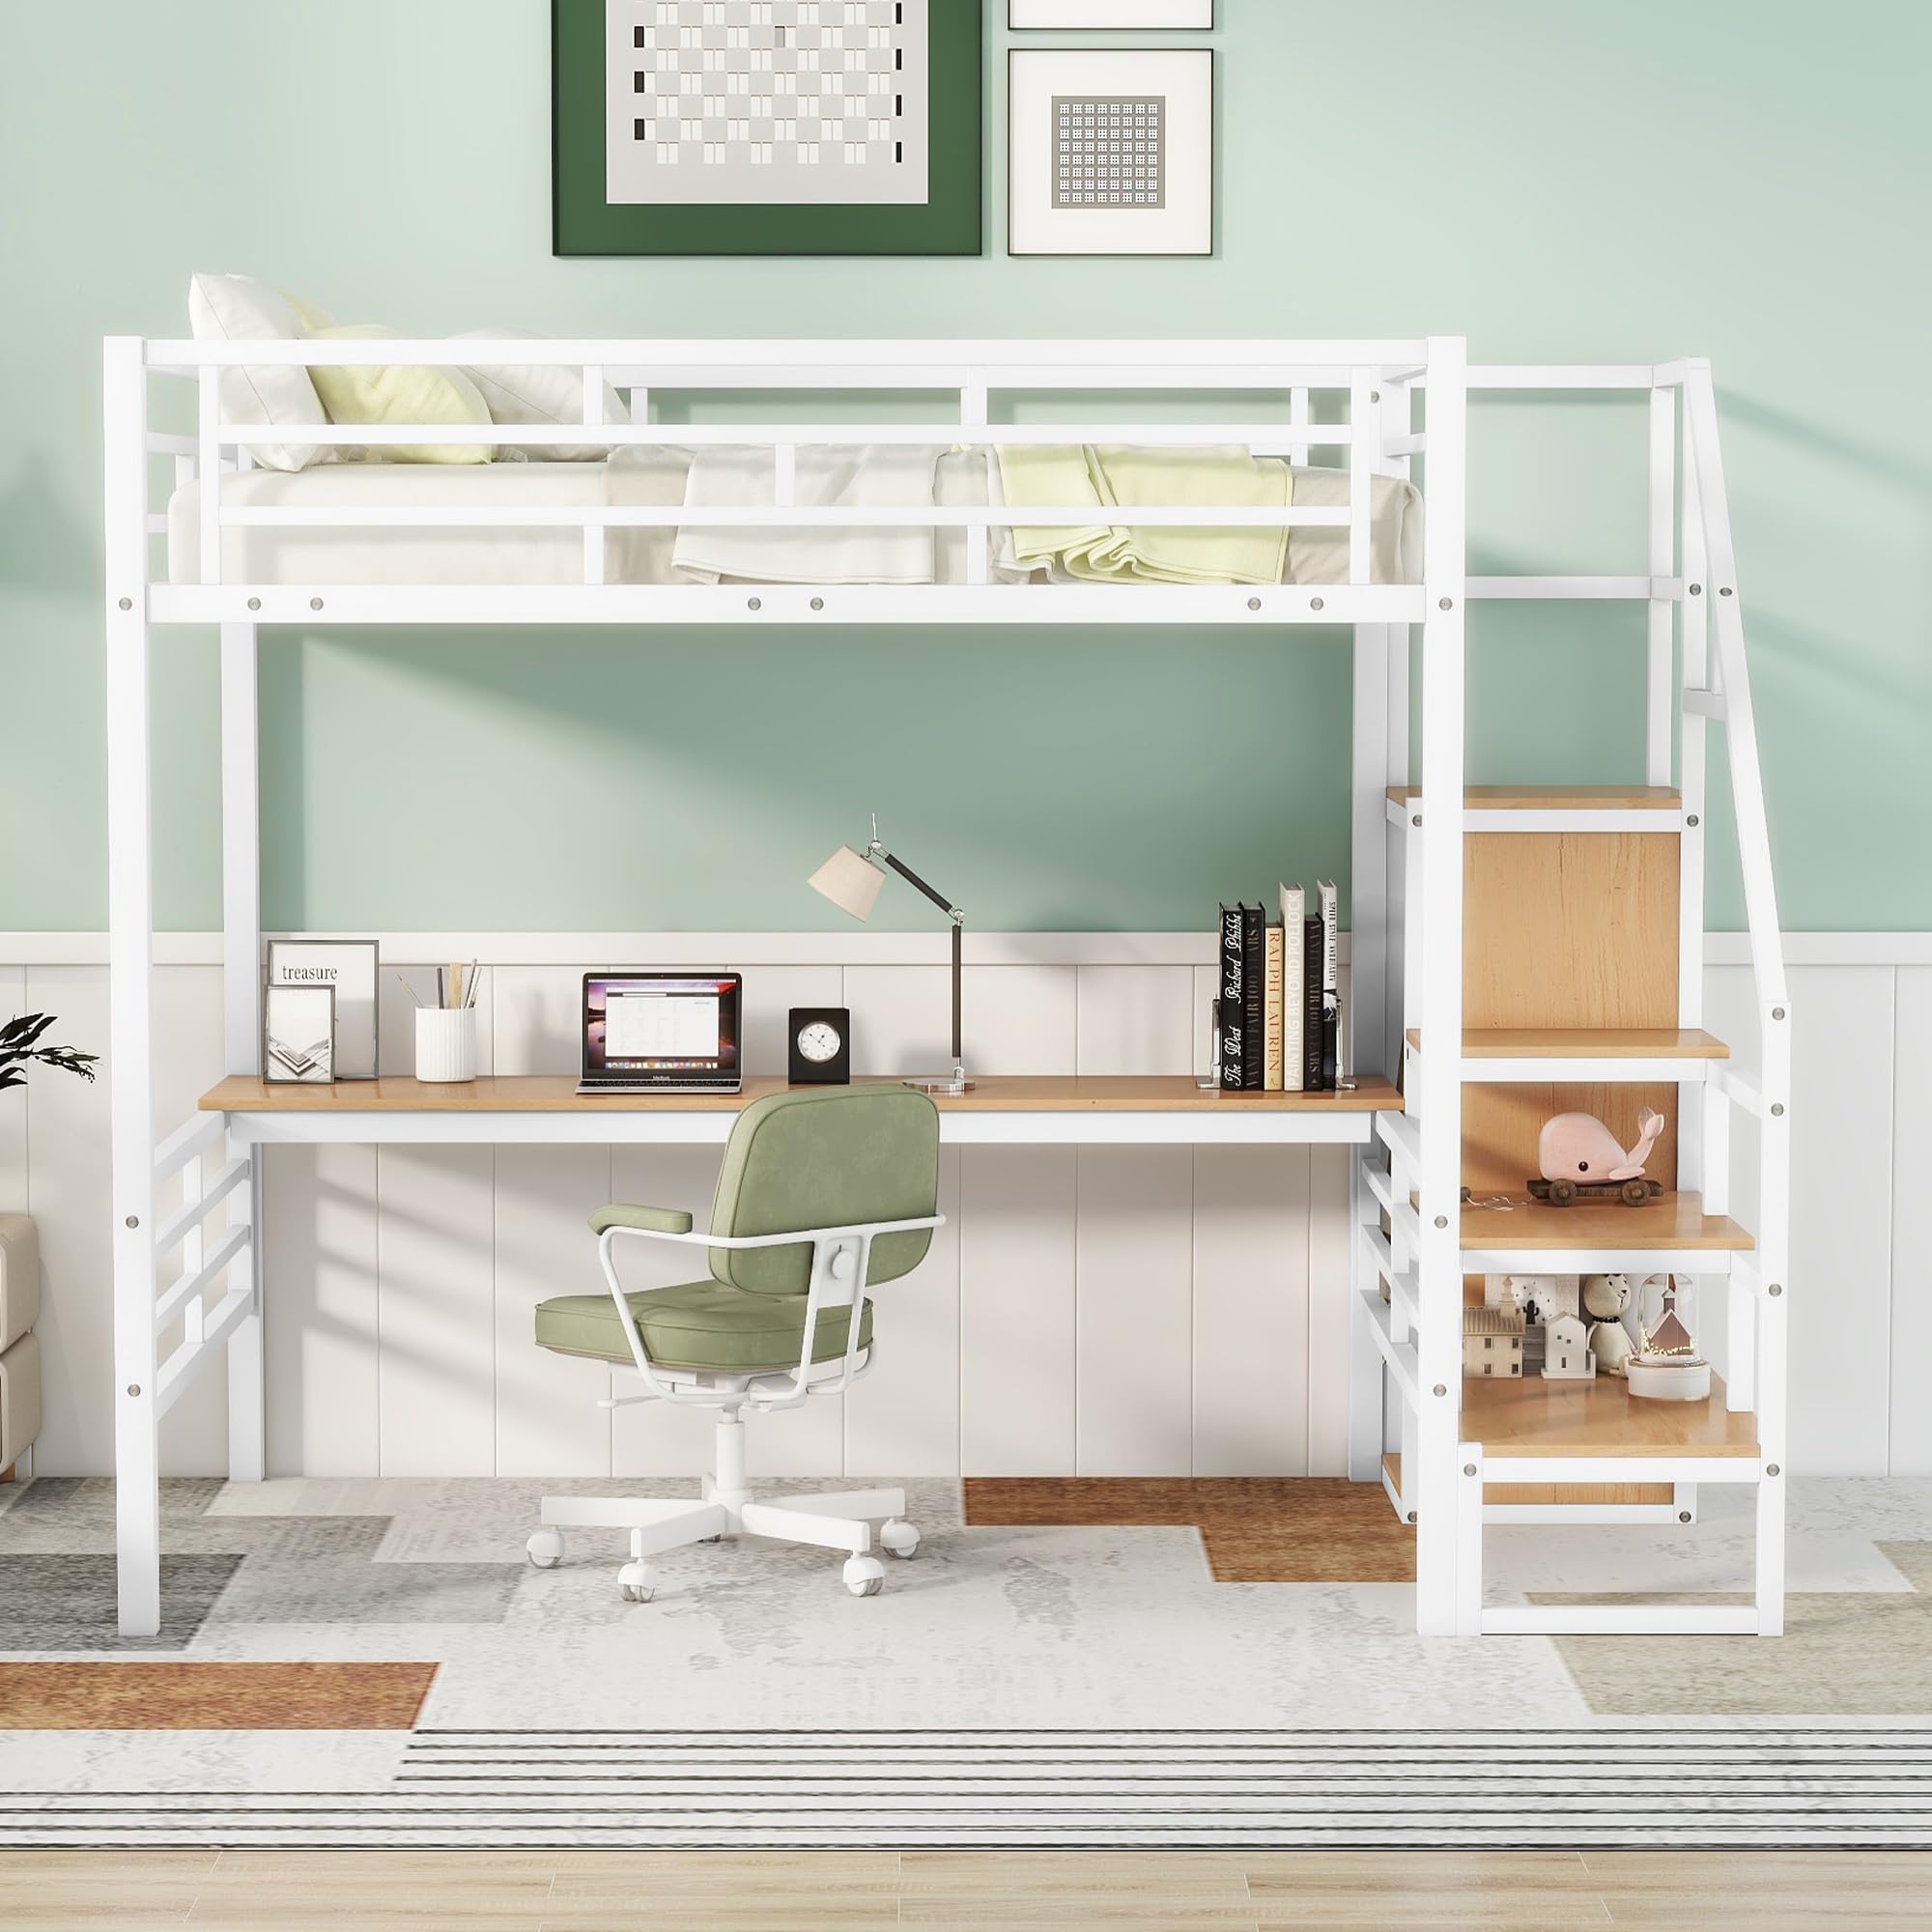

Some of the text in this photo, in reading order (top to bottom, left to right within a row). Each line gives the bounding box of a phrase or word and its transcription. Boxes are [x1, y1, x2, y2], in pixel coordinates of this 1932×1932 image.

[282, 966, 338, 980] treasure
[1224, 954, 1241, 1004] Richard
[1308, 974, 1321, 1003] FAIR
[1268, 932, 1281, 1071] RALPH LAUREN
[1288, 894, 1300, 1087] PAINTING BEYOND POLLOCK
[1246, 1003, 1259, 1034] FAIR
[1224, 1025, 1241, 1056] West
[1224, 1064, 1241, 1087] The
[1246, 1037, 1259, 1087] VANITY
